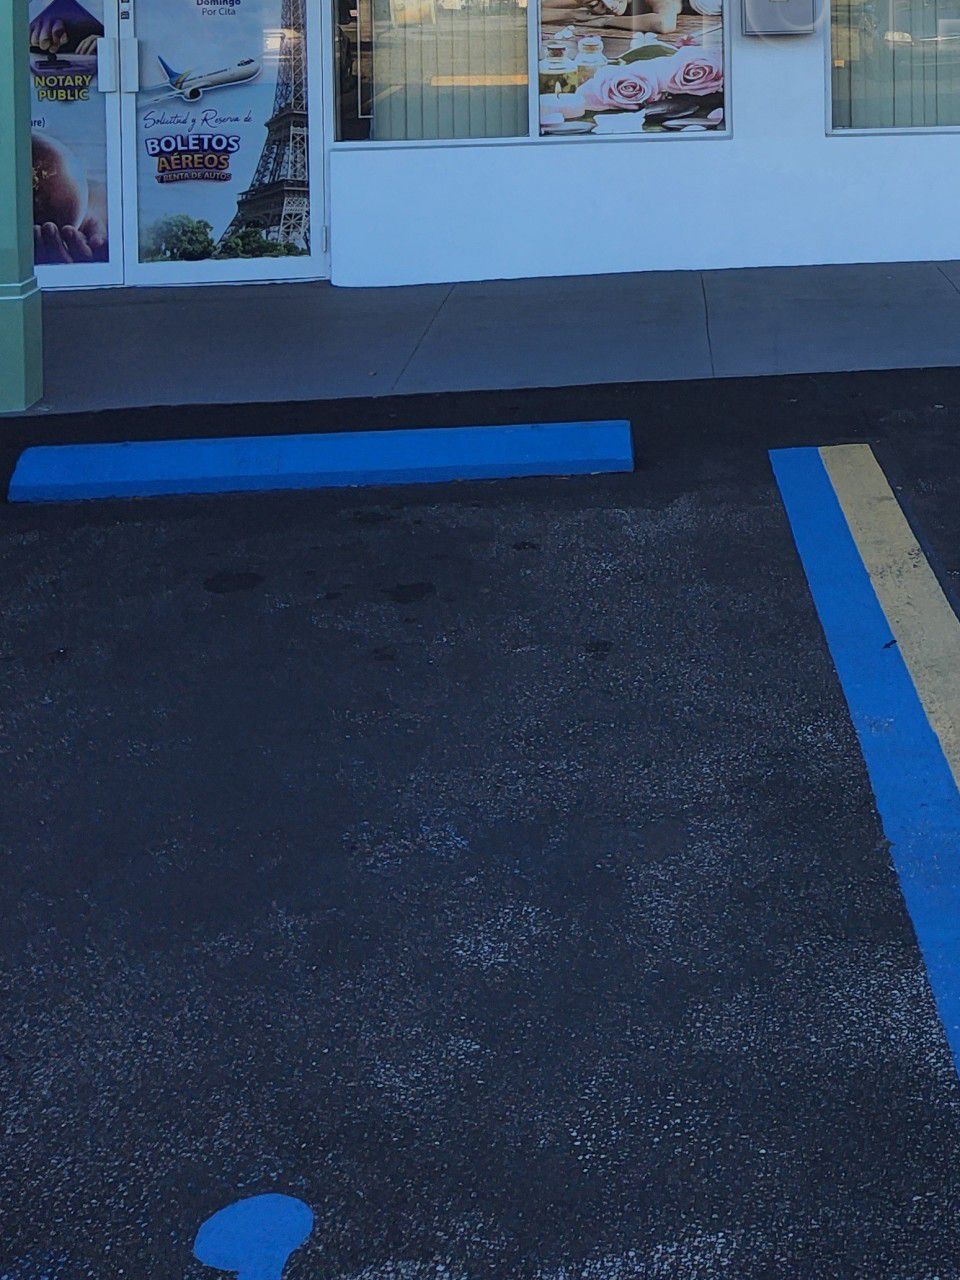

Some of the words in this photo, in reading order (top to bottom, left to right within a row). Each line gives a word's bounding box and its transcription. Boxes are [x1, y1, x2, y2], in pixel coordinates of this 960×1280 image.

[201, 7, 216, 16] Por
[218, 7, 236, 16] Cita
[34, 75, 92, 88] NOTARY
[38, 89, 90, 101] PUBLIC
[145, 133, 241, 155] BOLETOS
[157, 152, 231, 172] AÉREOS
[163, 171, 189, 182] RENTA
[203, 171, 232, 182] AUTOS
